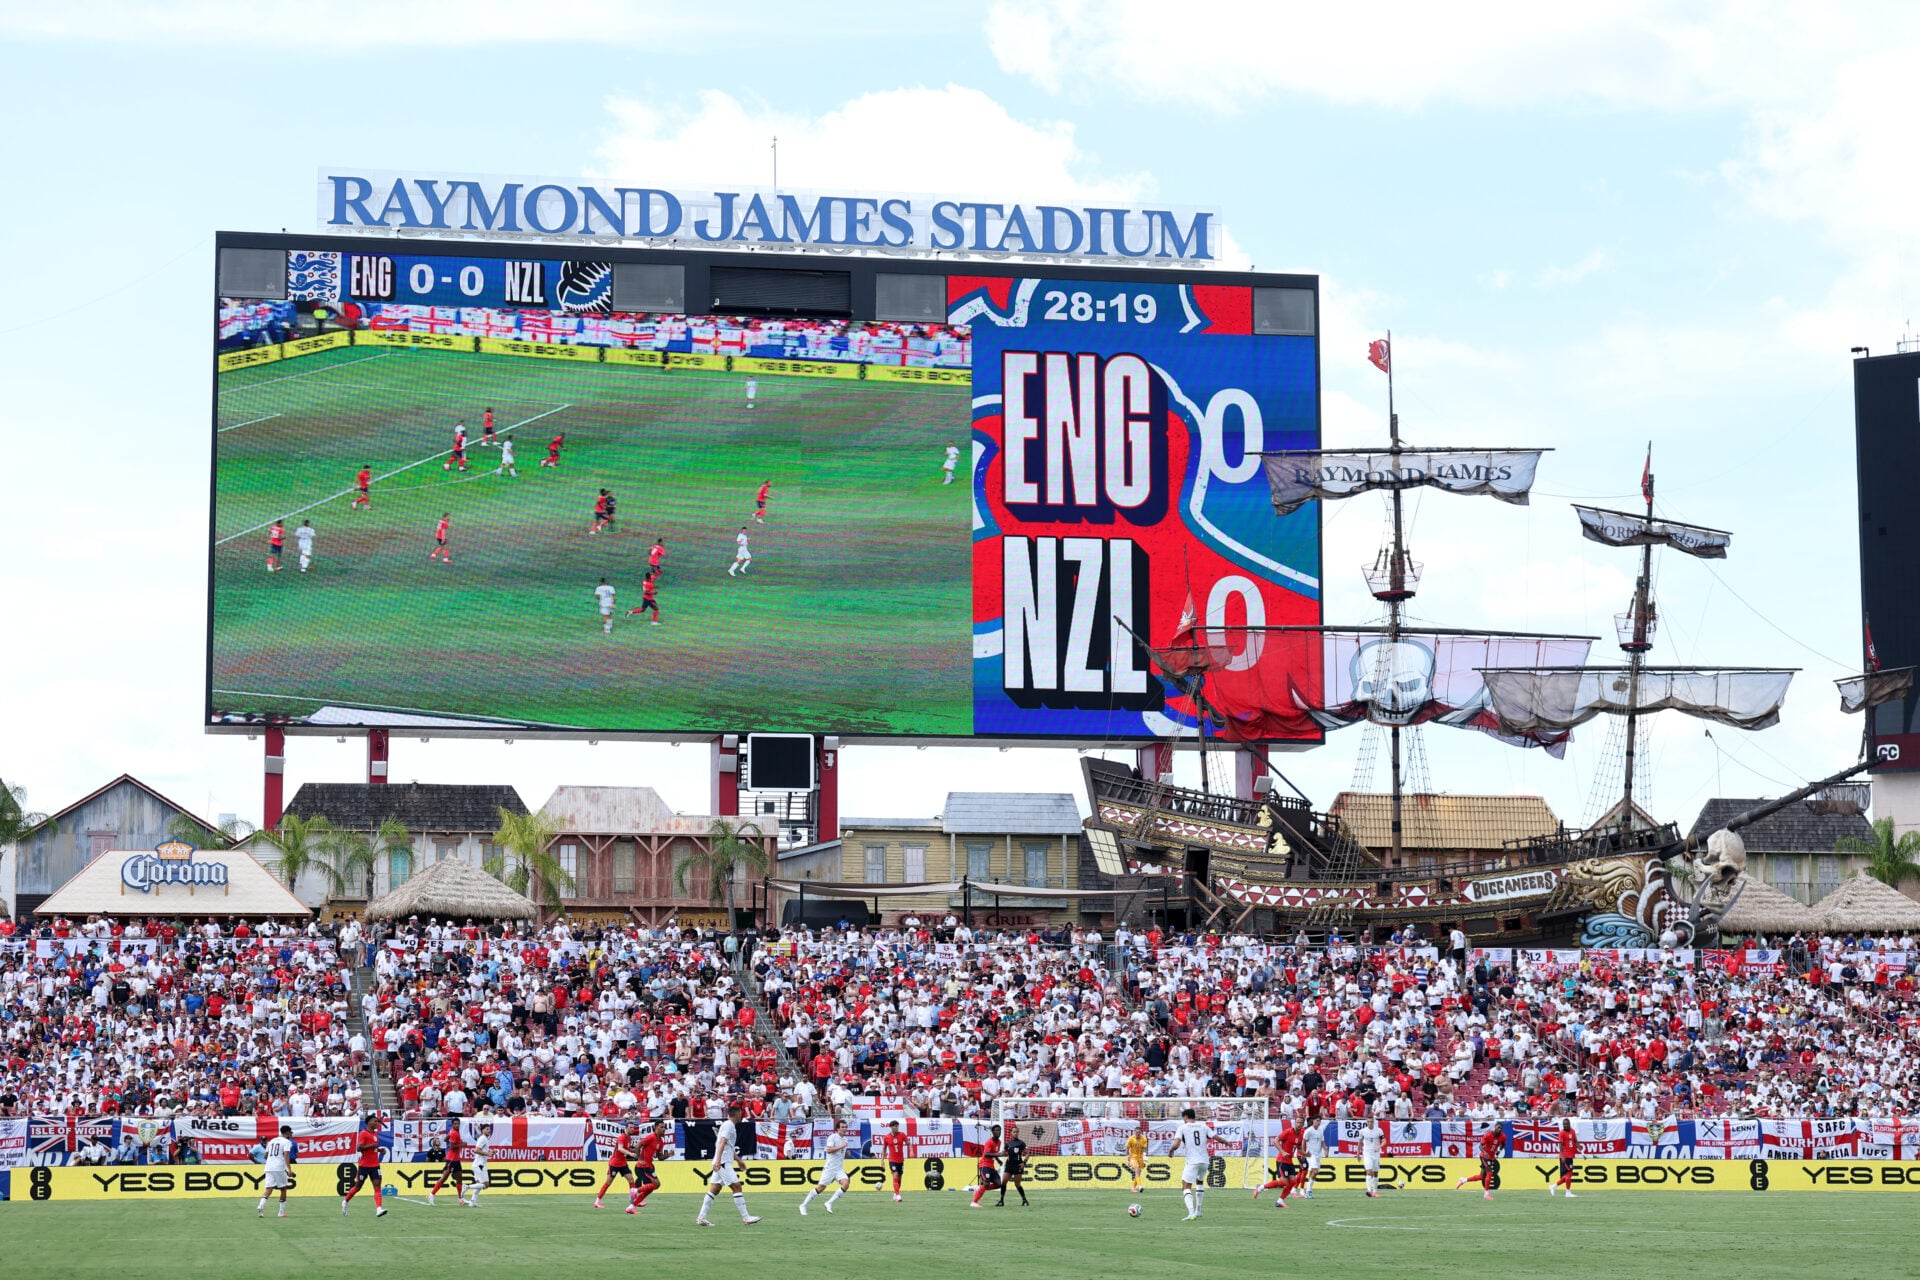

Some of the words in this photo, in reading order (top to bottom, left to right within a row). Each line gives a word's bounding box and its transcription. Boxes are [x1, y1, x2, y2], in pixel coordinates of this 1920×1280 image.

[327, 175, 683, 238] RAYMOND
[694, 191, 914, 248] JAMES
[931, 200, 1214, 260] STADIUM
[350, 255, 392, 298] ENG
[505, 262, 545, 303] NZL
[1043, 291, 1158, 323] 28:19
[1003, 352, 1151, 507] ENG
[1294, 465, 1425, 485] RAYMOND
[1003, 536, 1148, 694] NZL
[123, 856, 227, 891] Corona
[1472, 871, 1553, 900] BUCCANEERS
[568, 917, 588, 927] THE
[675, 917, 694, 927] THE
[698, 917, 730, 929] GALLE
[985, 913, 1035, 927] GRILL
[31, 1126, 55, 1135] ISLE
[57, 1127, 72, 1135] OF
[75, 1127, 111, 1135] WIGHT
[191, 1119, 240, 1131] Mate
[1216, 1126, 1241, 1136] BCFC
[1731, 1124, 1757, 1132] LENNY
[1817, 1120, 1846, 1133] SAFC
[297, 1135, 352, 1154] ckett
[921, 1135, 951, 1145] TOWN
[1061, 1130, 1104, 1144] SOUTHAMPTON
[1193, 1130, 1200, 1146] 8
[1779, 1136, 1836, 1148] DURHAM
[196, 1140, 256, 1156] immy
[269, 1143, 280, 1157] 10
[1386, 1145, 1422, 1154] ROVERS
[1523, 1141, 1560, 1153] DONN
[1577, 1141, 1615, 1153] OWLS
[1767, 1149, 1799, 1160] AMBER
[548, 1149, 583, 1161] ALBION
[396, 1169, 474, 1189] YES
[488, 1168, 595, 1188] BOYS
[1068, 1162, 1171, 1182] BOYS
[1616, 1165, 1715, 1184] BOYS
[1802, 1166, 1874, 1184] YES
[93, 1171, 174, 1192] YES
